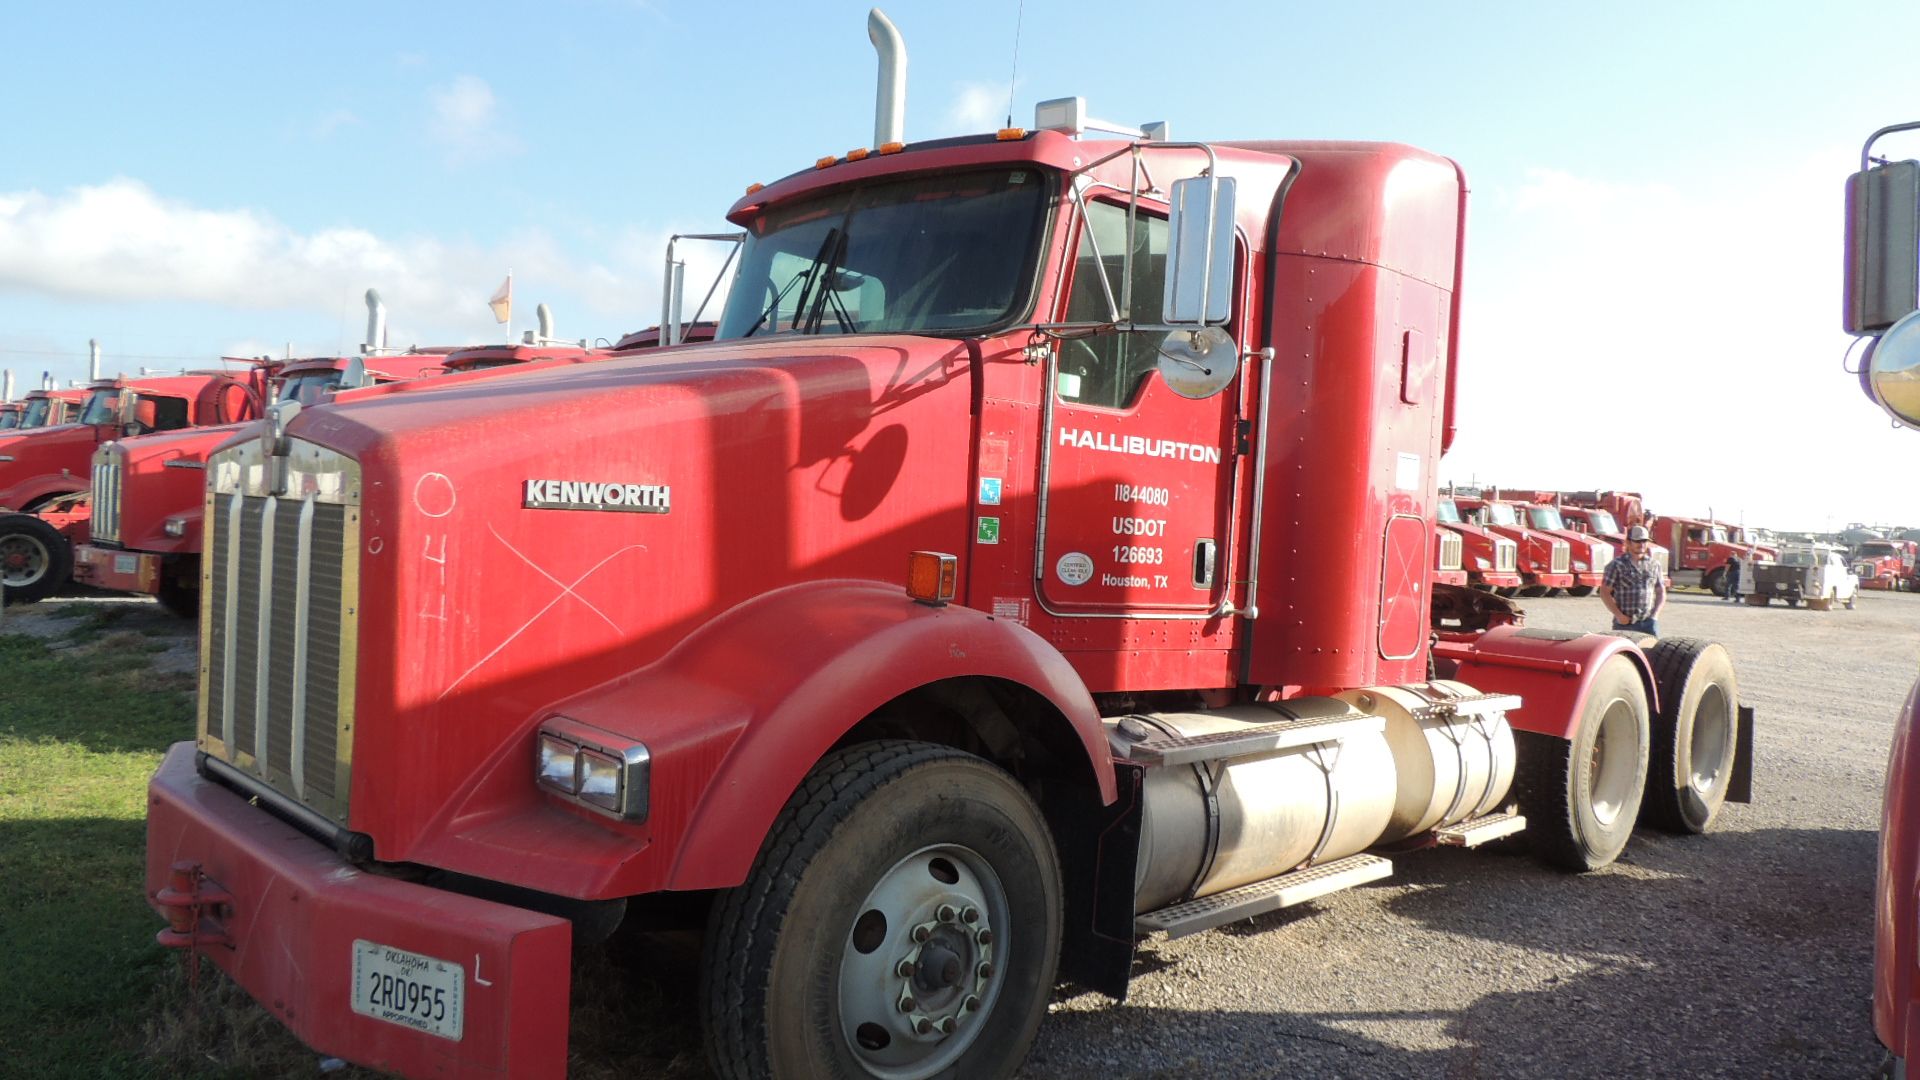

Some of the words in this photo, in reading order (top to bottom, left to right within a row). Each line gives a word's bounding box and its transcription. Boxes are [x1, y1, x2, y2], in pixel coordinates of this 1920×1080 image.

[1059, 427, 1221, 464] HALLIBURTON
[527, 479, 671, 508] KENWORTH
[1114, 483, 1169, 506] 11844080
[1112, 516, 1167, 537] USDOT
[1112, 545, 1163, 565] 126693
[1102, 573, 1151, 590] Houston,
[1153, 575, 1169, 589] TX
[385, 950, 430, 972] OKLAHOMA
[369, 971, 446, 1022] 2RD955
[382, 1010, 429, 1030] APPORTIONED
